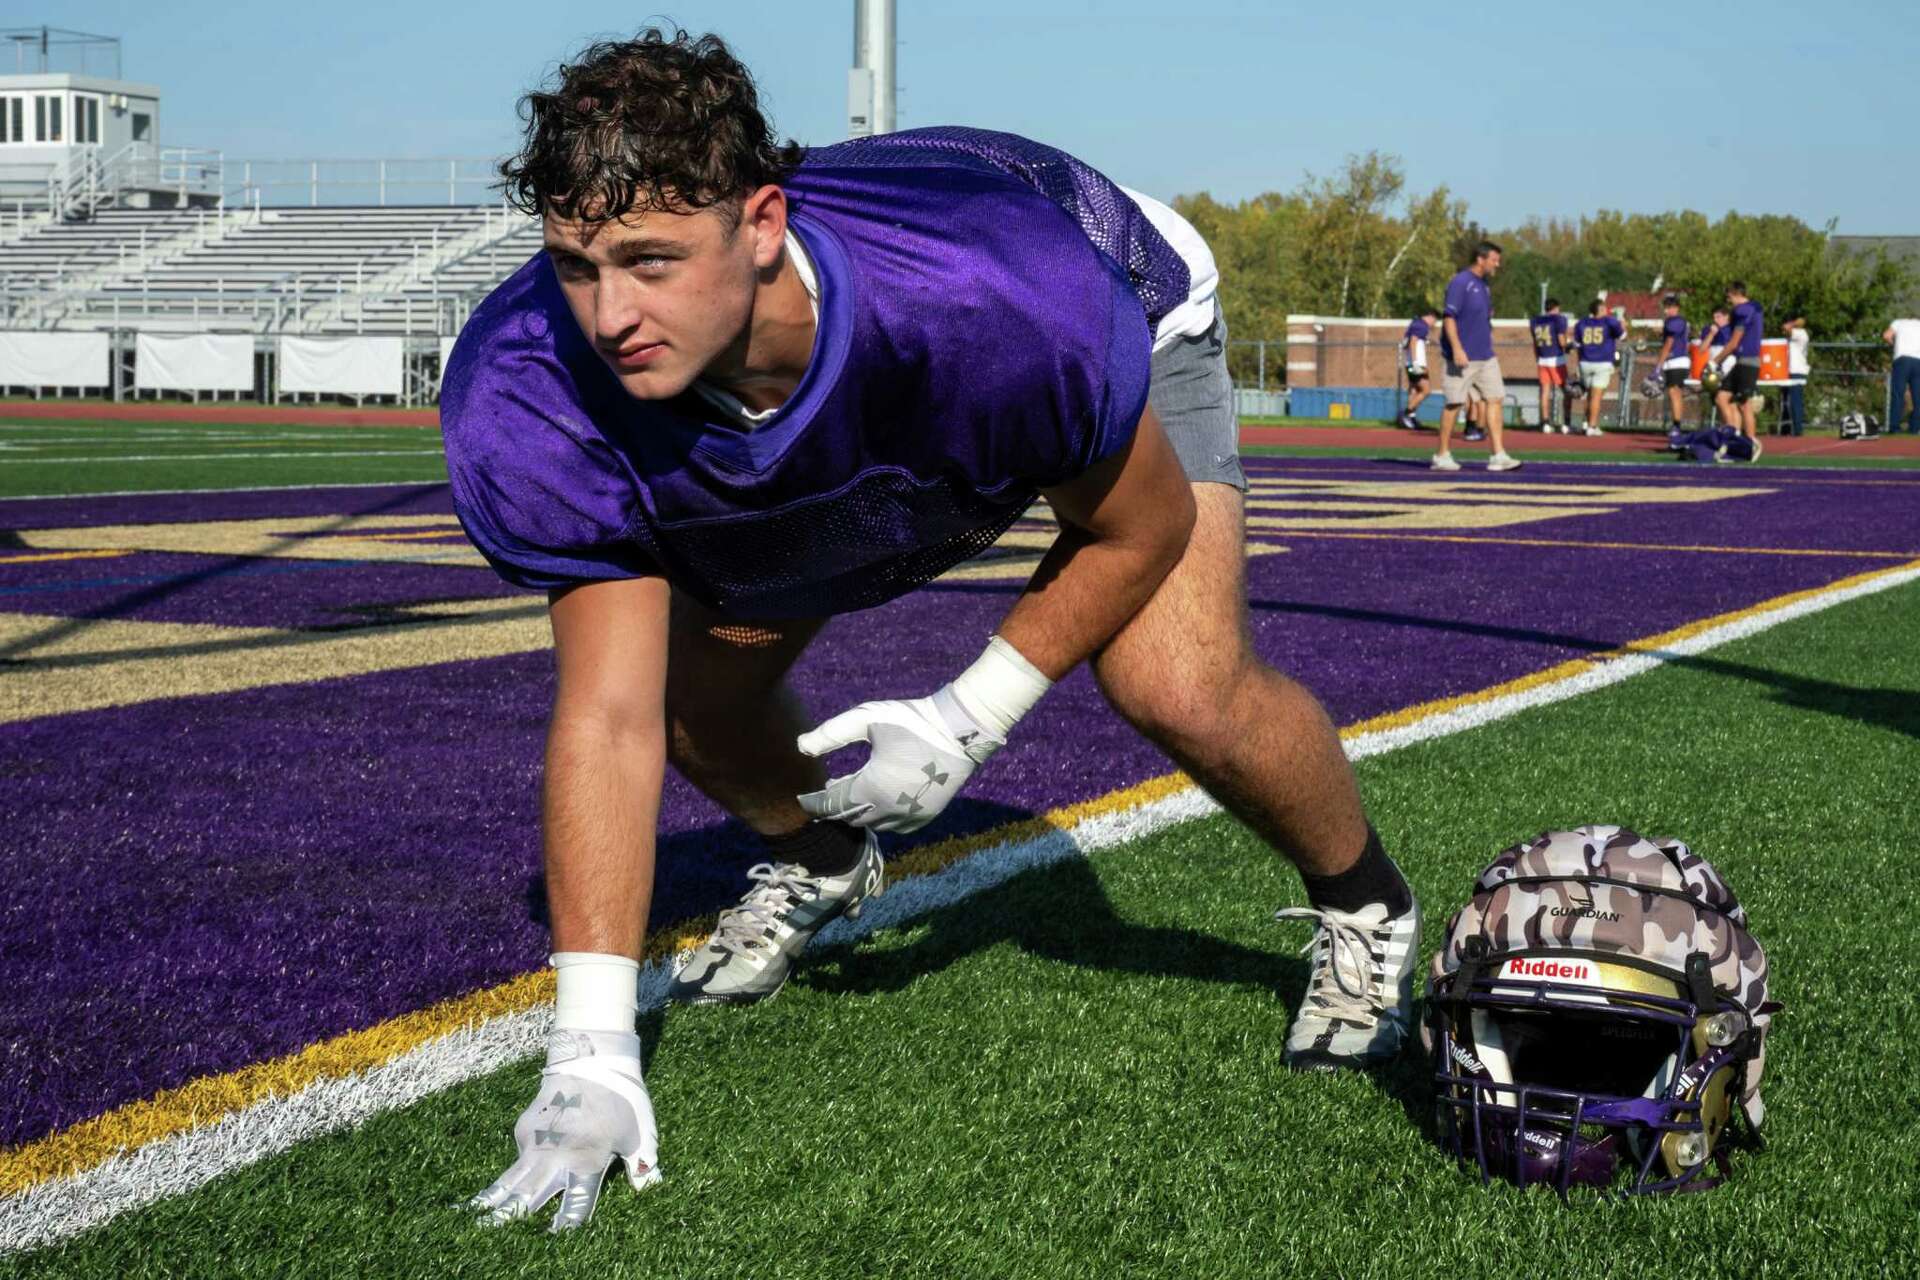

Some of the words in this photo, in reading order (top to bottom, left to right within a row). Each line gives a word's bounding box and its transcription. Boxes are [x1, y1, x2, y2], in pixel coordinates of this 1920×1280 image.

[1582, 326, 1604, 345] 85
[1551, 906, 1620, 922] GUARDIAN
[1510, 957, 1588, 979] Riddell
[1514, 1128, 1556, 1150] ddell
